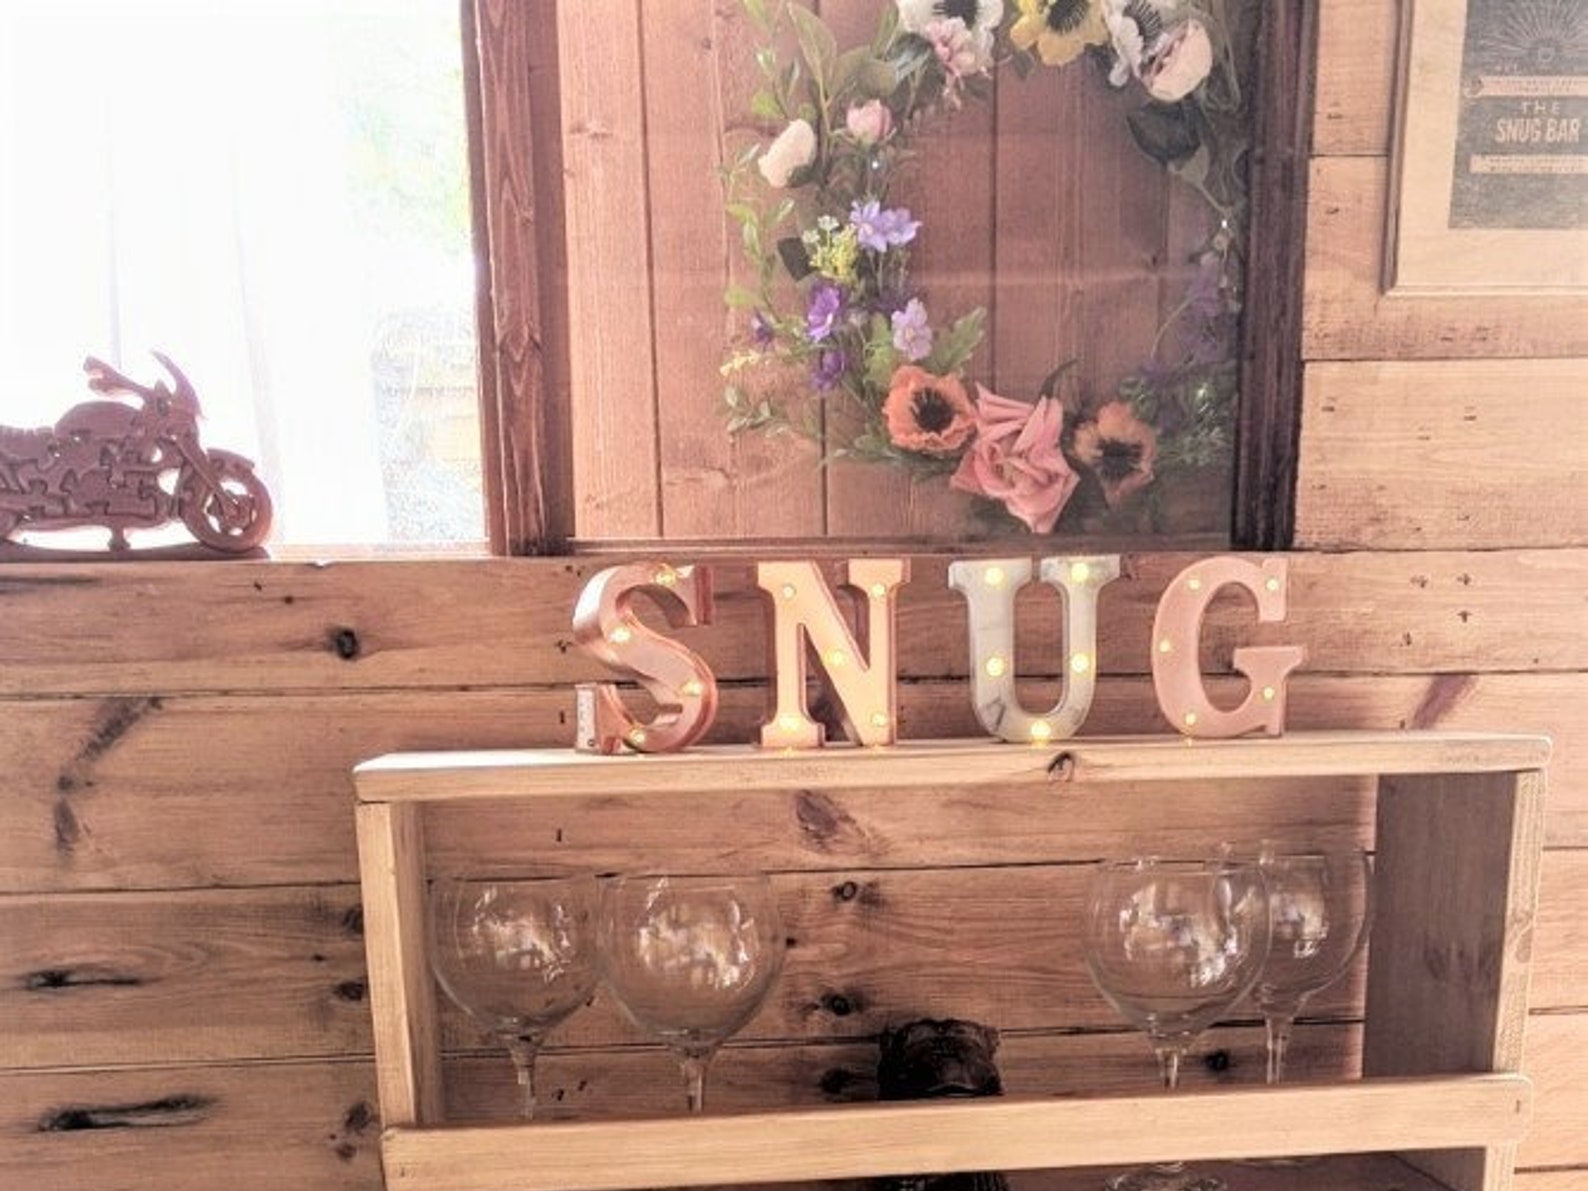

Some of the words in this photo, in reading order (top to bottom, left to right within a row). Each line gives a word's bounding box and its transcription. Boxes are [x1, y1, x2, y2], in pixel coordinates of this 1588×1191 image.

[1522, 100, 1560, 114] THE
[1495, 118, 1541, 143] SNUG
[1545, 118, 1580, 143] BAR
[567, 555, 1305, 753] SNUG
